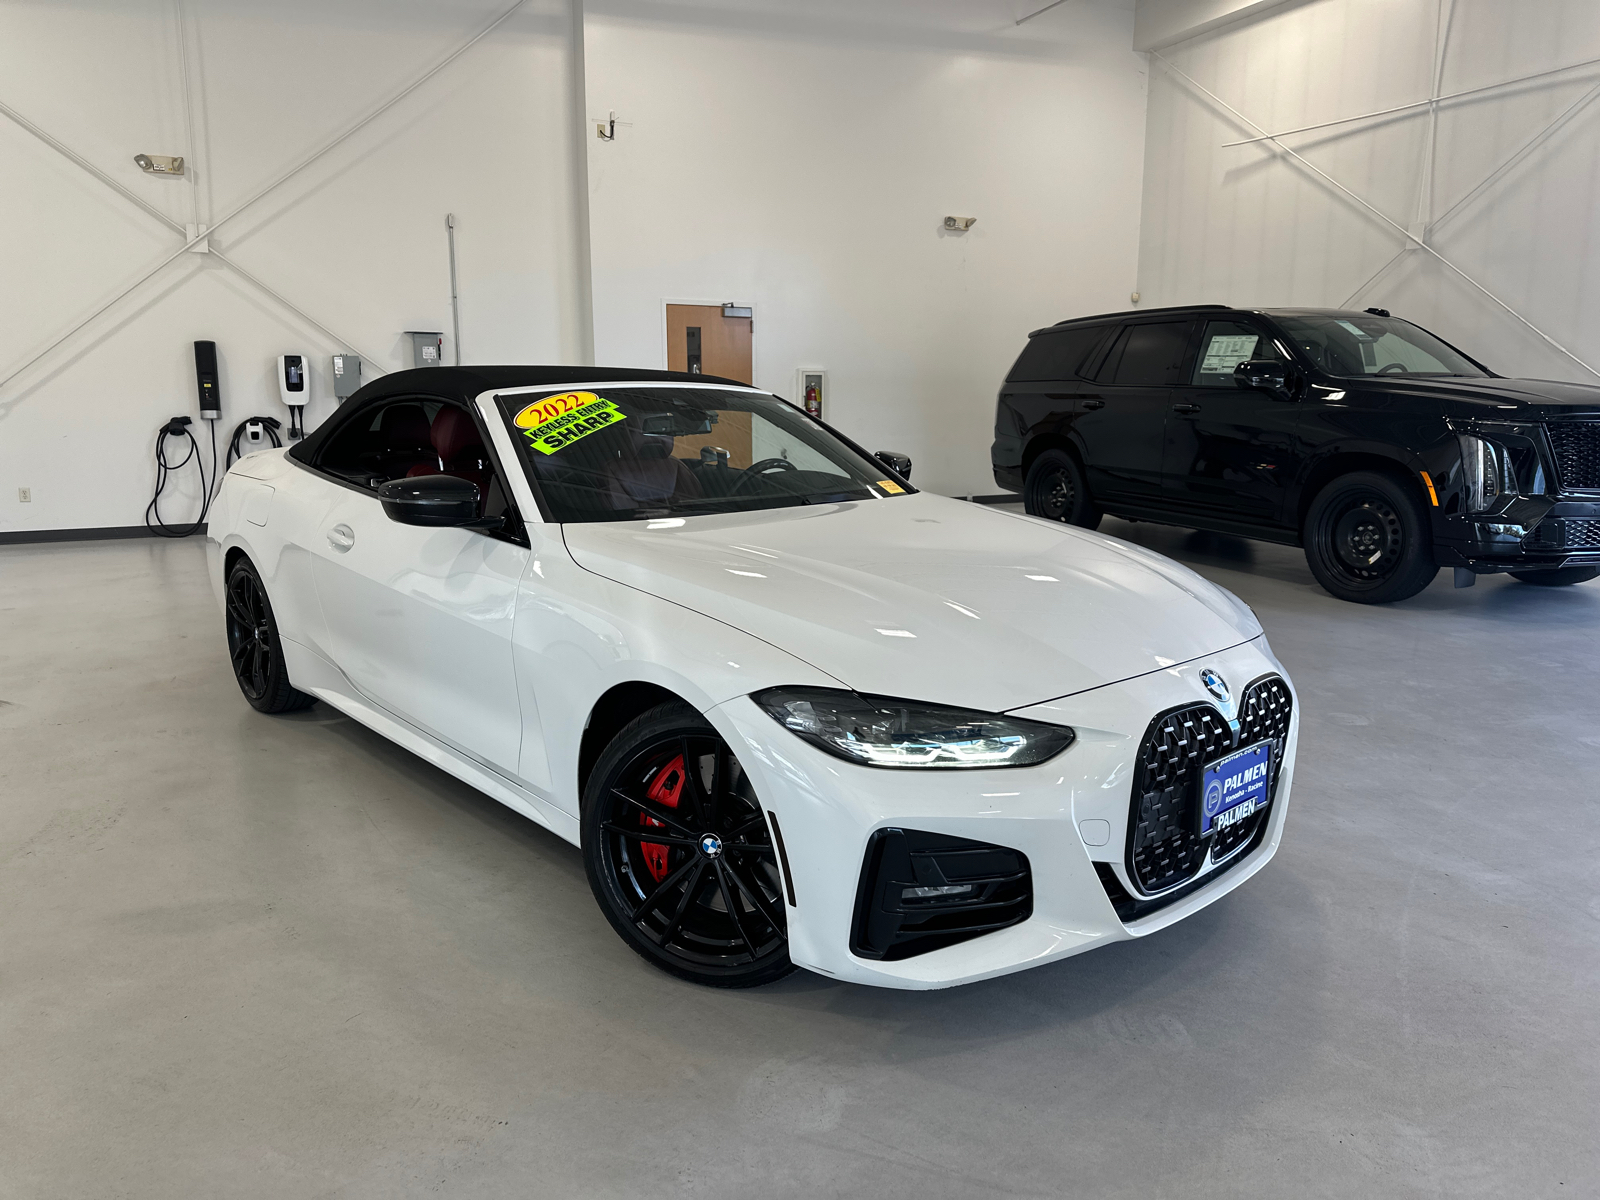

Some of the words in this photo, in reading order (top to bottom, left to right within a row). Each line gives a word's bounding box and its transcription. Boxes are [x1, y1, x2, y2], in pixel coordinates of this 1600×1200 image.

[529, 394, 585, 424] 2022
[529, 413, 581, 439] KEYLESS
[575, 400, 612, 417] ENTRY
[543, 411, 615, 449] SHARP
[1220, 746, 1258, 767] palmen.com
[1223, 761, 1268, 794] PALMEN
[1225, 788, 1245, 804] Kenosha
[1247, 781, 1264, 793] Racine
[1217, 798, 1256, 831] PALMEN
